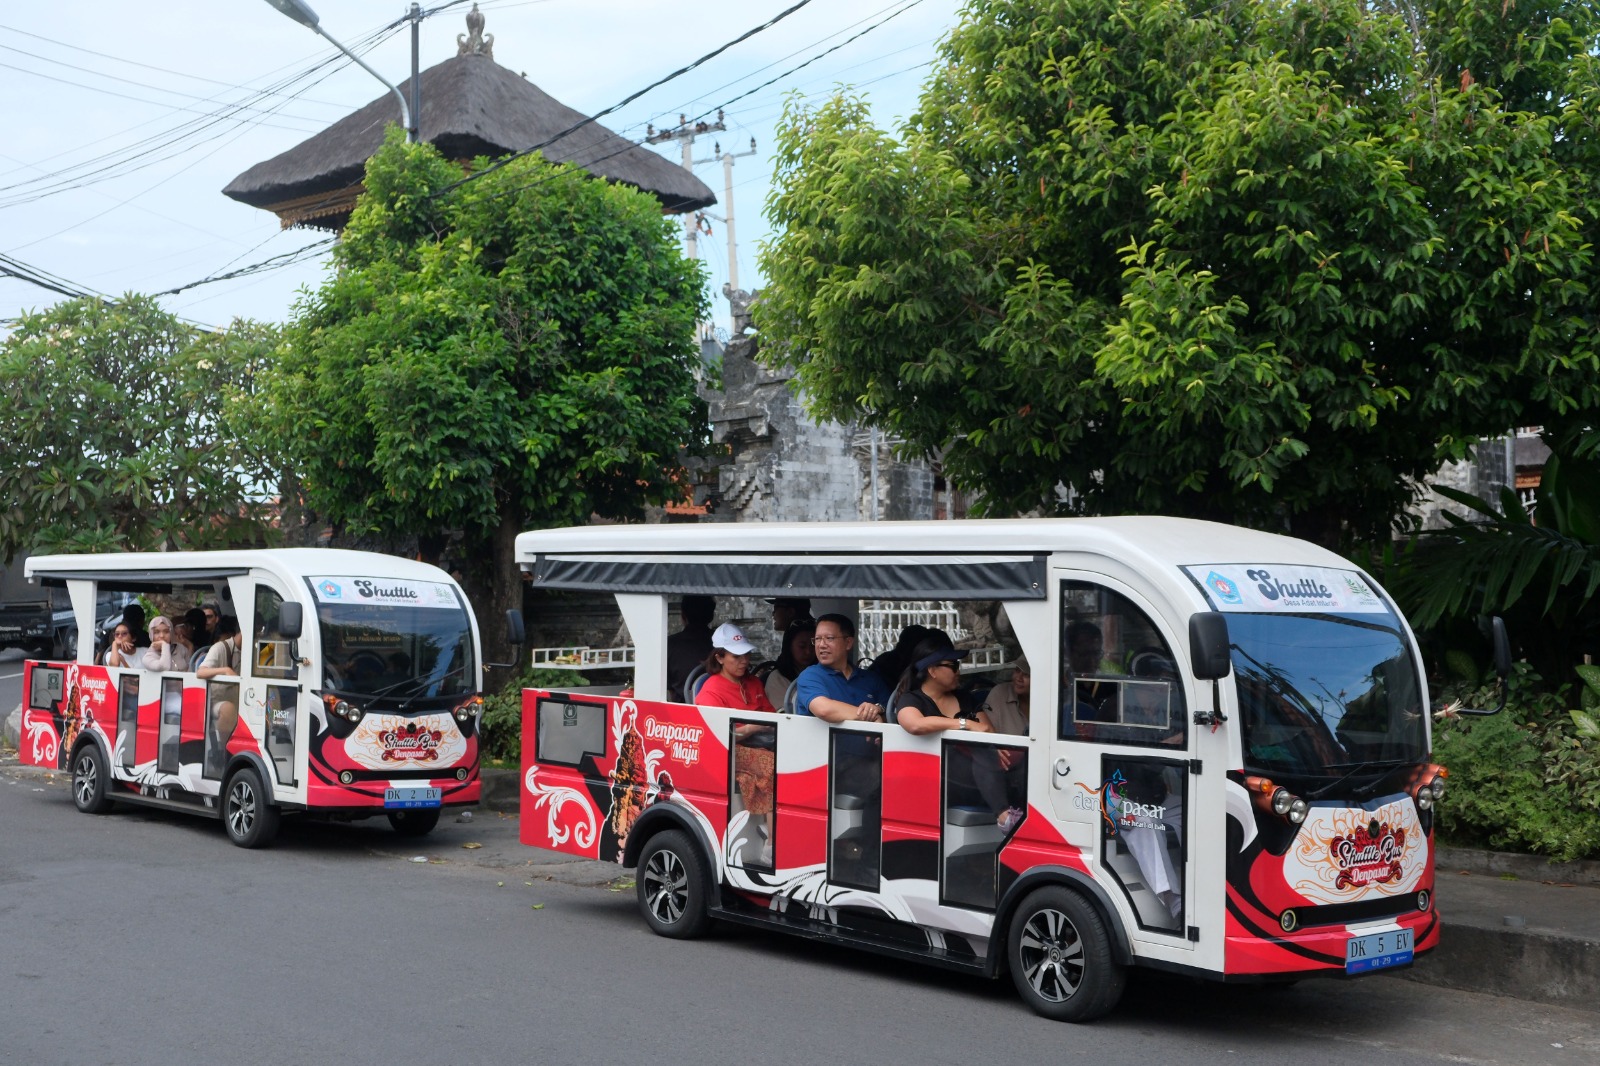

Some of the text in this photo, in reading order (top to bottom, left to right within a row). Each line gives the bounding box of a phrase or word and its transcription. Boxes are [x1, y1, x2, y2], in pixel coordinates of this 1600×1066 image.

[353, 579, 418, 598] Shuttle
[1246, 569, 1332, 601] Shuttle
[1301, 599, 1315, 607] Adat
[81, 675, 108, 693] Denpasar
[93, 690, 106, 704] Maju
[272, 709, 290, 720] pasar
[384, 731, 438, 749] Shuttle Bus
[645, 717, 703, 745] Denpasar
[393, 750, 425, 759] Denpasar
[672, 742, 698, 765] Maju
[387, 788, 438, 800] DK 2 EV
[1122, 800, 1166, 820] pasar
[1337, 835, 1404, 869] Shuttle Bus
[1351, 866, 1390, 885] Denpasar
[1351, 932, 1409, 958] DK 5 EV
